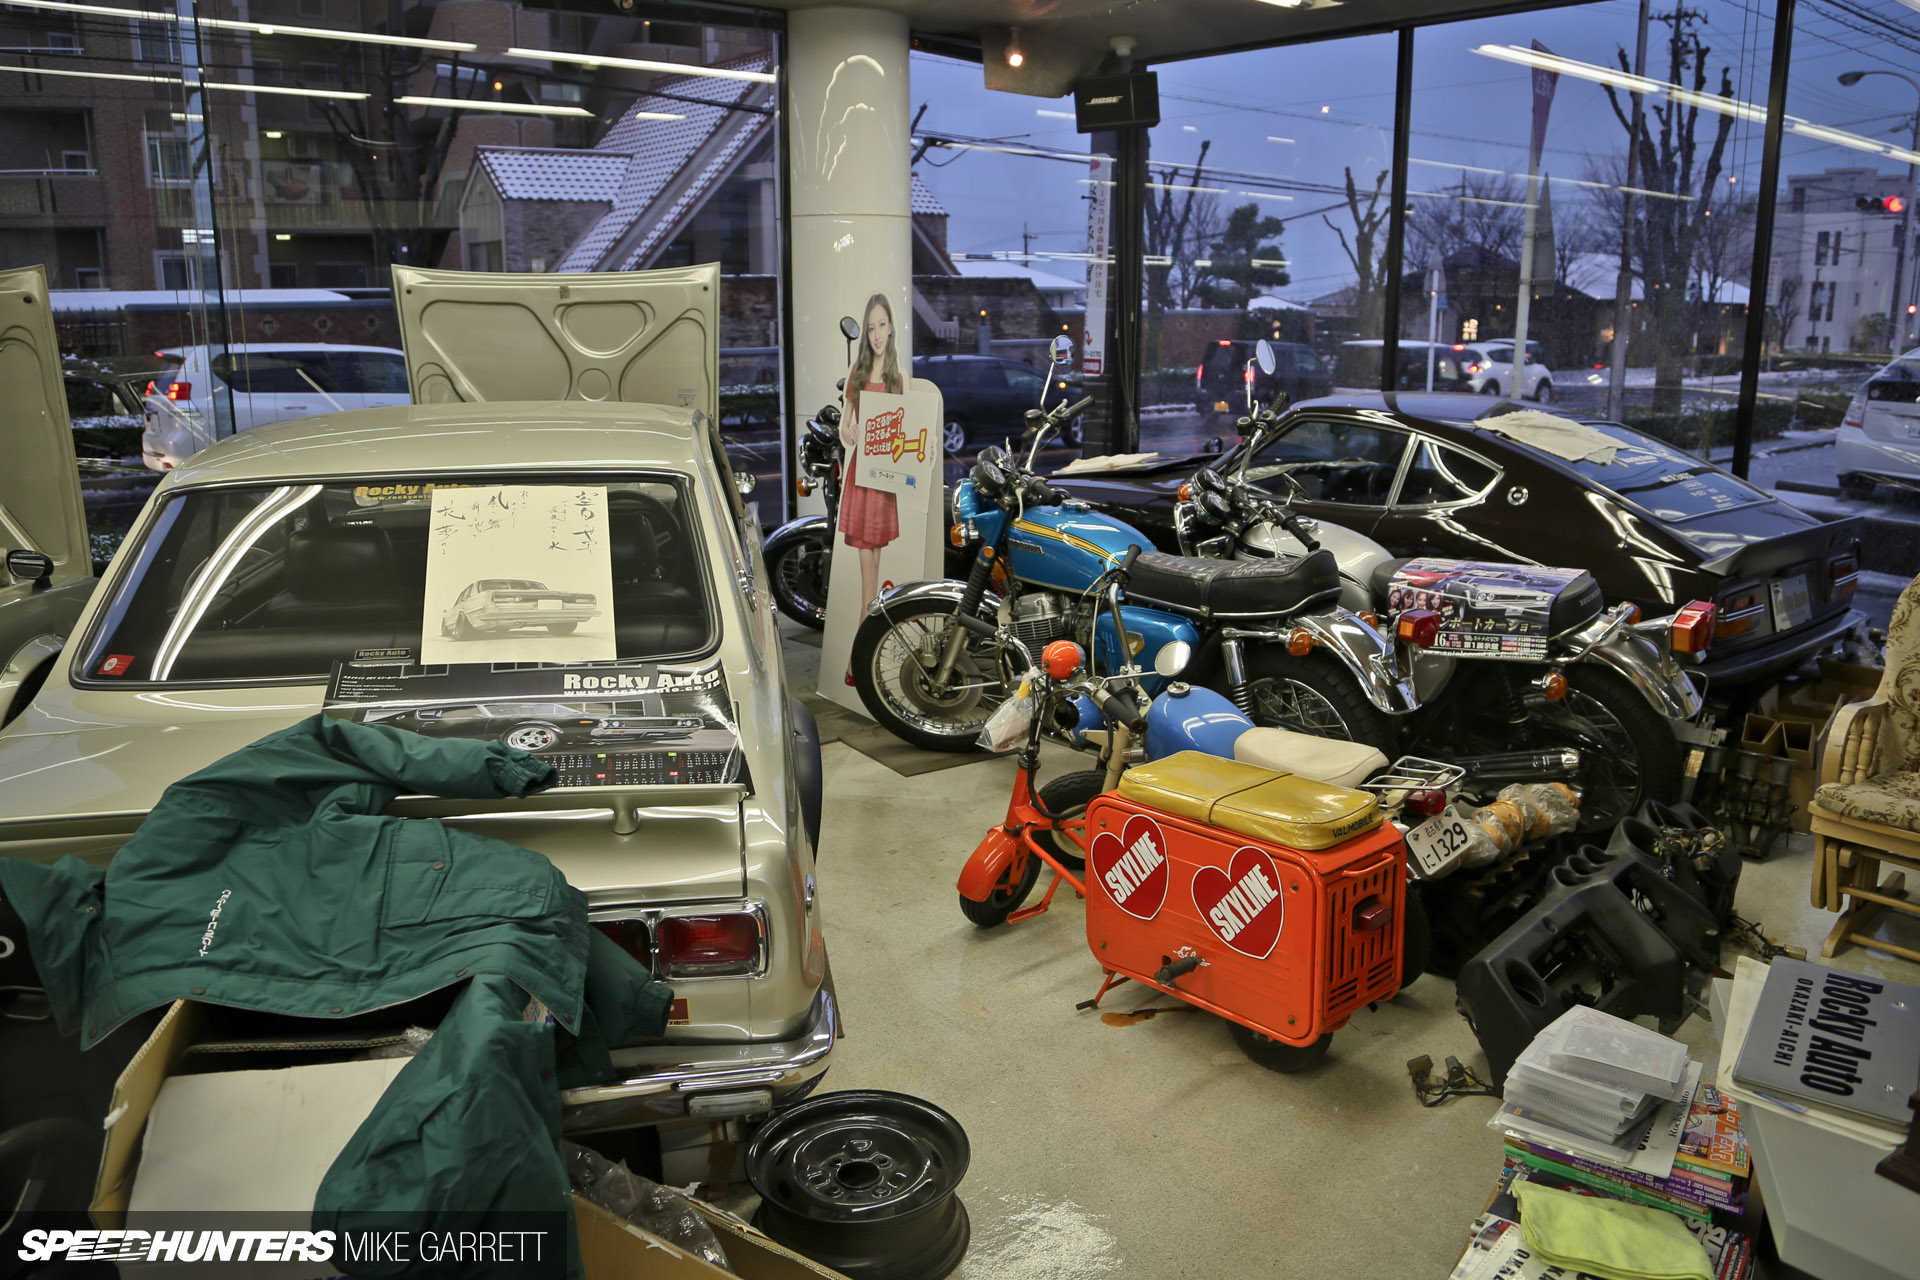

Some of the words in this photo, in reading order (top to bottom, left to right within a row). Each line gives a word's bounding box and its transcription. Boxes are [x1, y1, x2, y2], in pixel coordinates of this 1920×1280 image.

[355, 485, 419, 497] Rocky
[563, 674, 650, 690] Rocky
[657, 669, 720, 688] Auto
[1332, 813, 1375, 839] VALMOBILE
[1104, 830, 1165, 904] SKYLINE
[1209, 863, 1279, 942] SKYLINE
[1808, 972, 1885, 1043] Rocky
[1800, 1034, 1873, 1097] Auto
